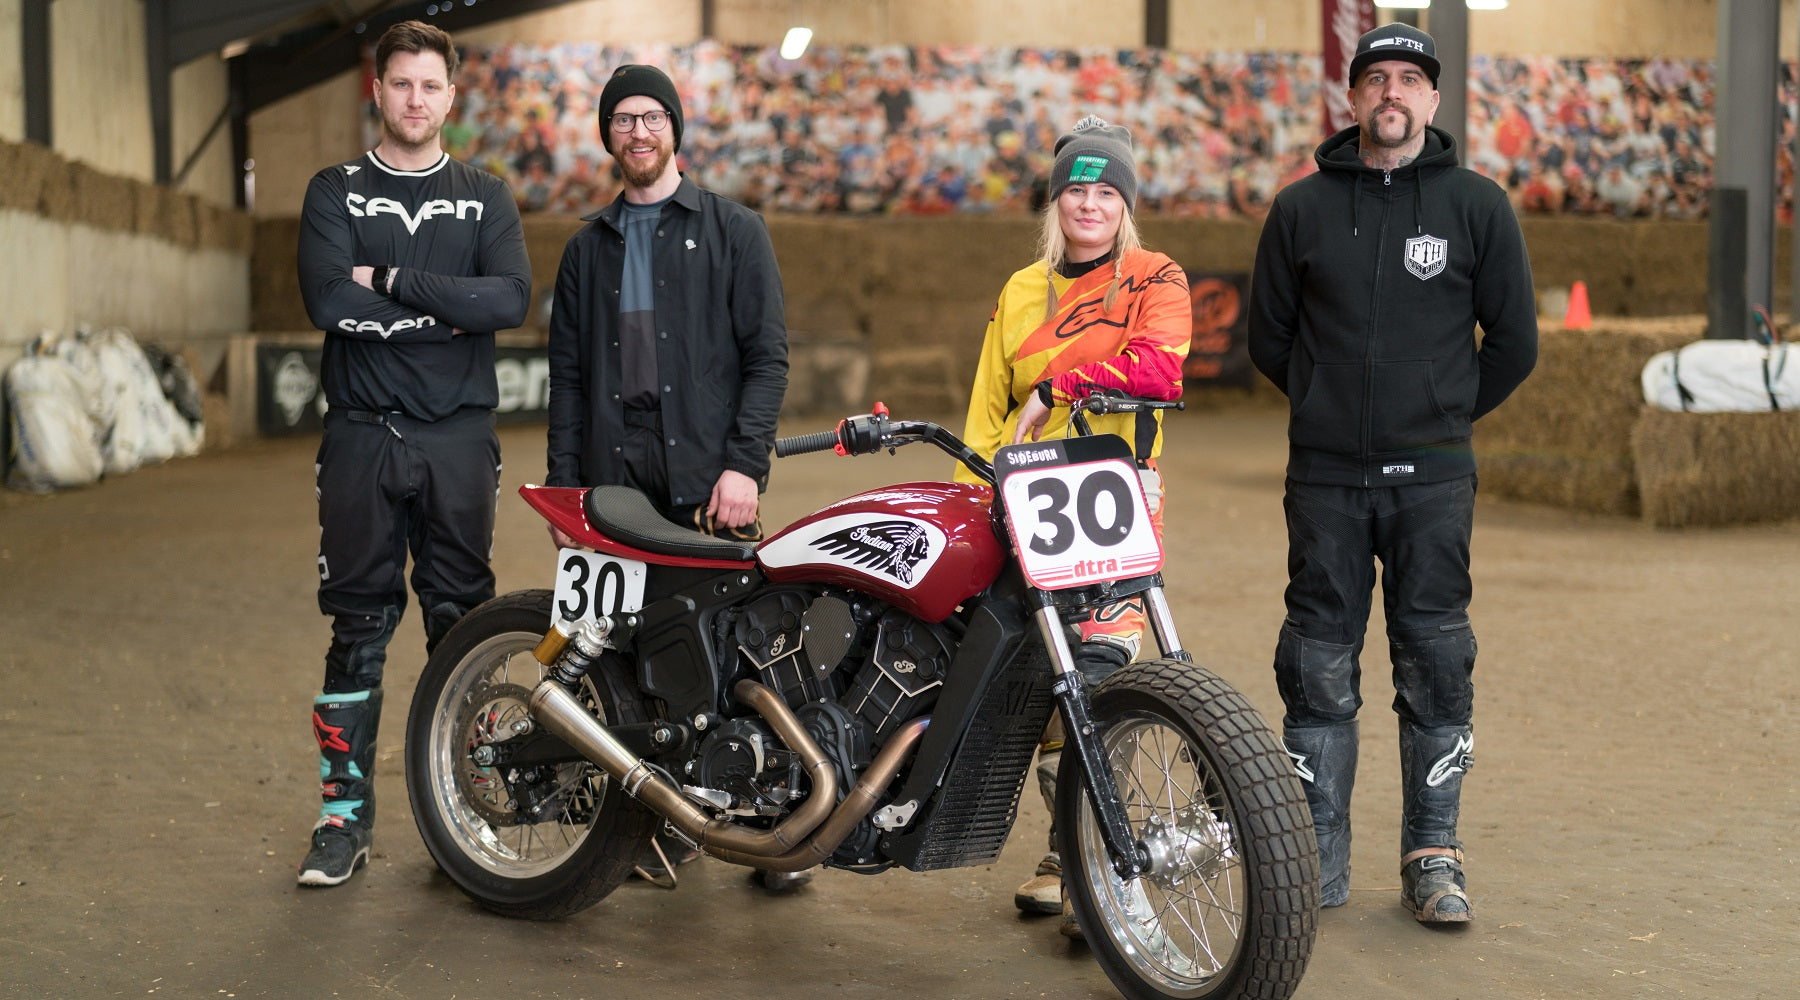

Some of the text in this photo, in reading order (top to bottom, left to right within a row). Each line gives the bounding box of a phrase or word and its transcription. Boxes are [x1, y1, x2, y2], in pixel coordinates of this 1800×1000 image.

[1394, 36, 1424, 53] FTH
[1412, 241, 1441, 264] FTH
[1007, 448, 1058, 466] SIDEBURN
[1027, 470, 1135, 556] 30
[850, 526, 894, 552] Indian
[1074, 558, 1118, 577] dtra
[559, 555, 625, 623] 30
